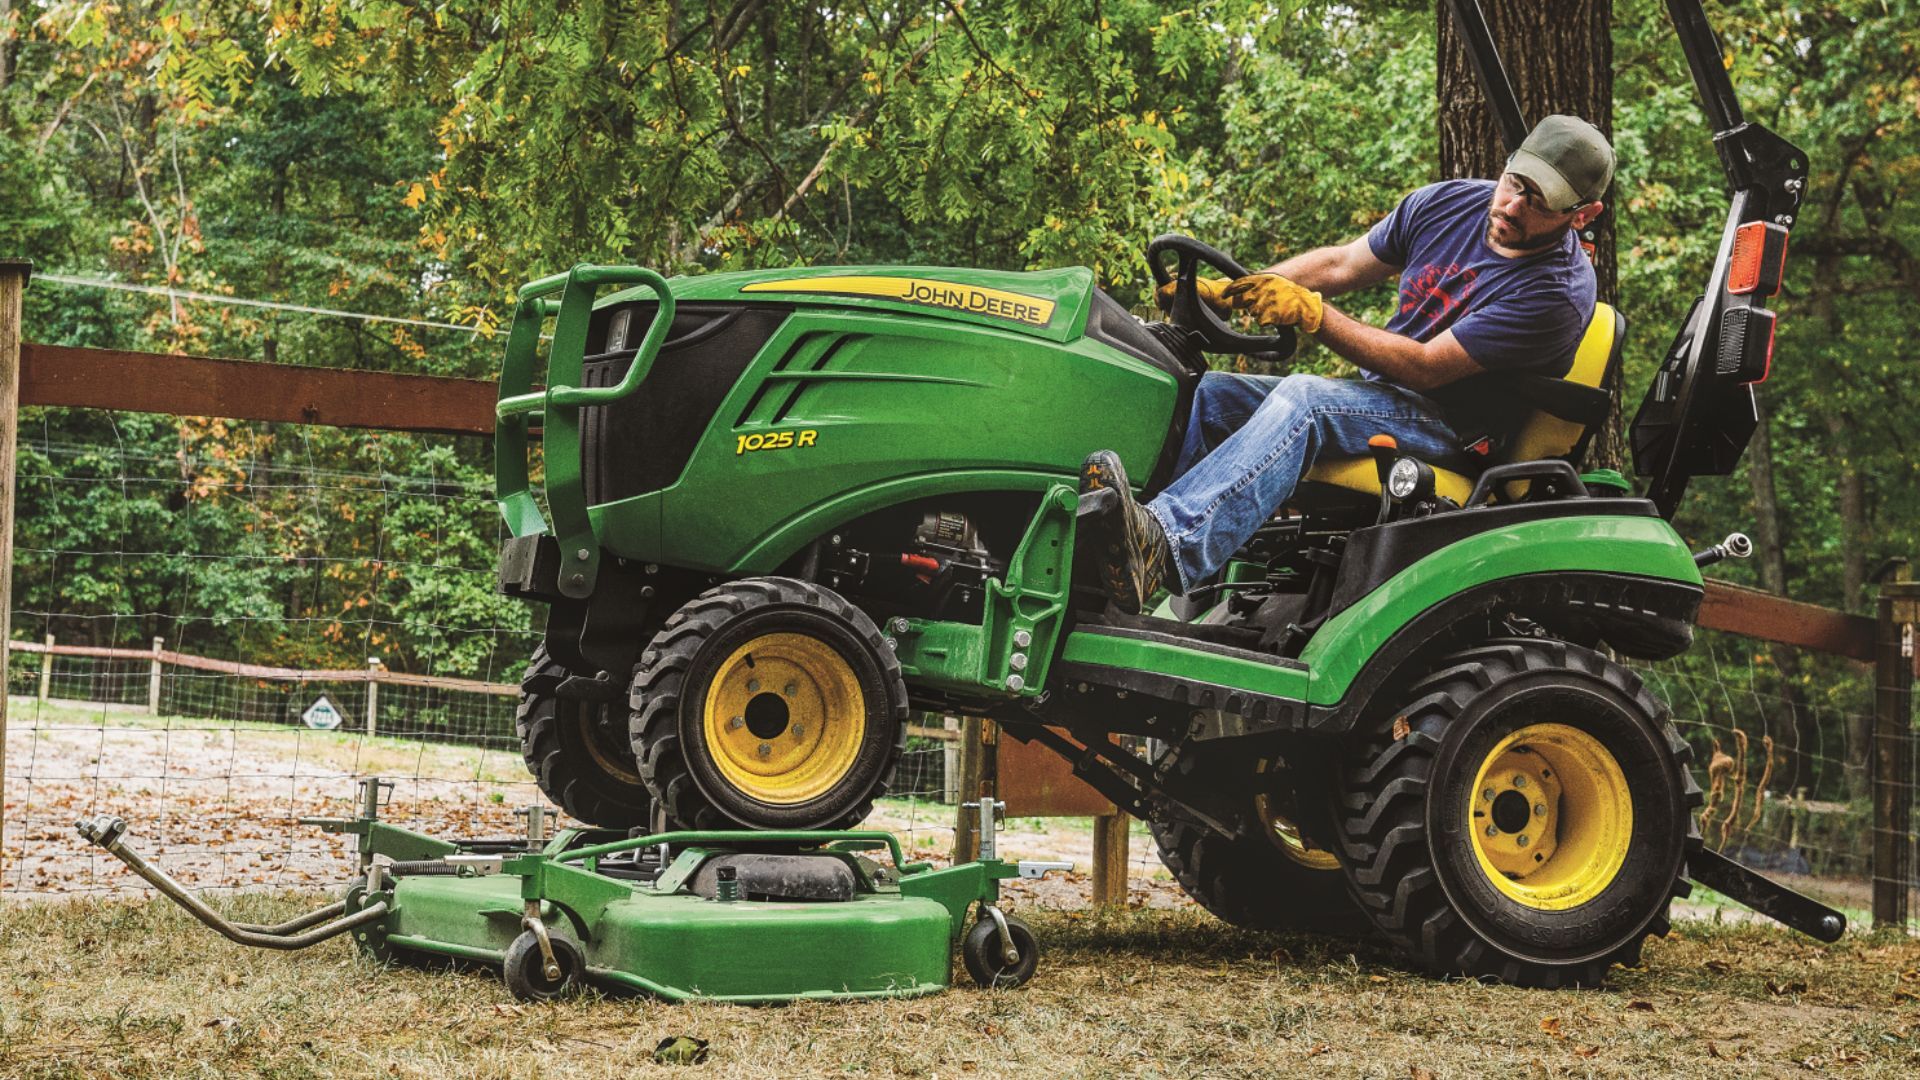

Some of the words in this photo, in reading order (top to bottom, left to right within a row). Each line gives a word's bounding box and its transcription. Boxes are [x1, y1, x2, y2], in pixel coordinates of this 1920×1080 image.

[902, 282, 964, 307] JOHN
[969, 291, 1041, 322] DEERE
[736, 430, 796, 455] 1025
